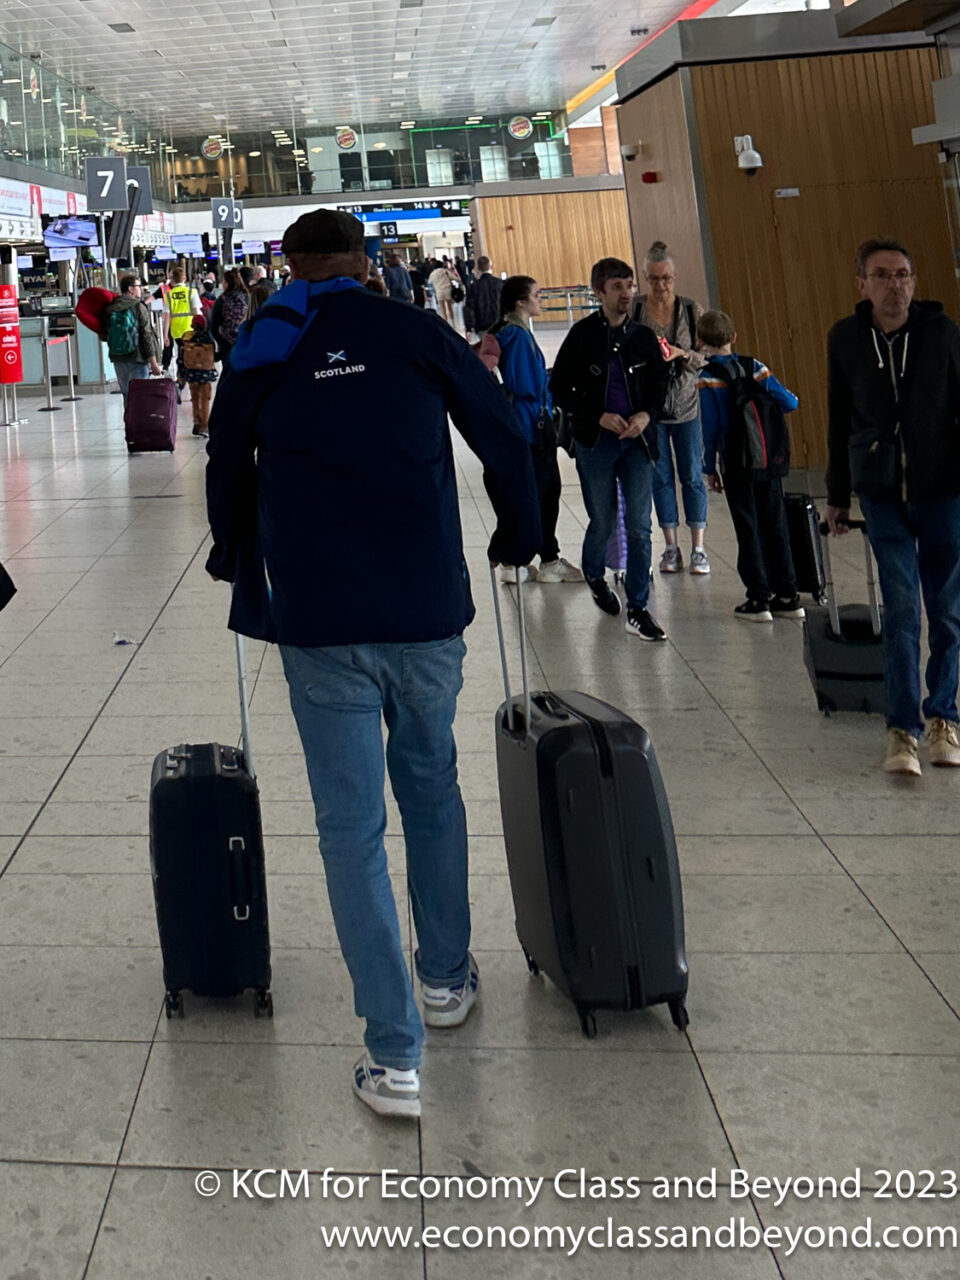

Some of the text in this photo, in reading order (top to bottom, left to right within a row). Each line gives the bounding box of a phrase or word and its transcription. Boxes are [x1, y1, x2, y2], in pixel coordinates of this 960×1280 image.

[97, 171, 114, 197] 7
[218, 205, 228, 221] 9
[234, 210, 240, 223] 0
[382, 225, 396, 235] 13
[314, 364, 365, 379] SCOTLAND
